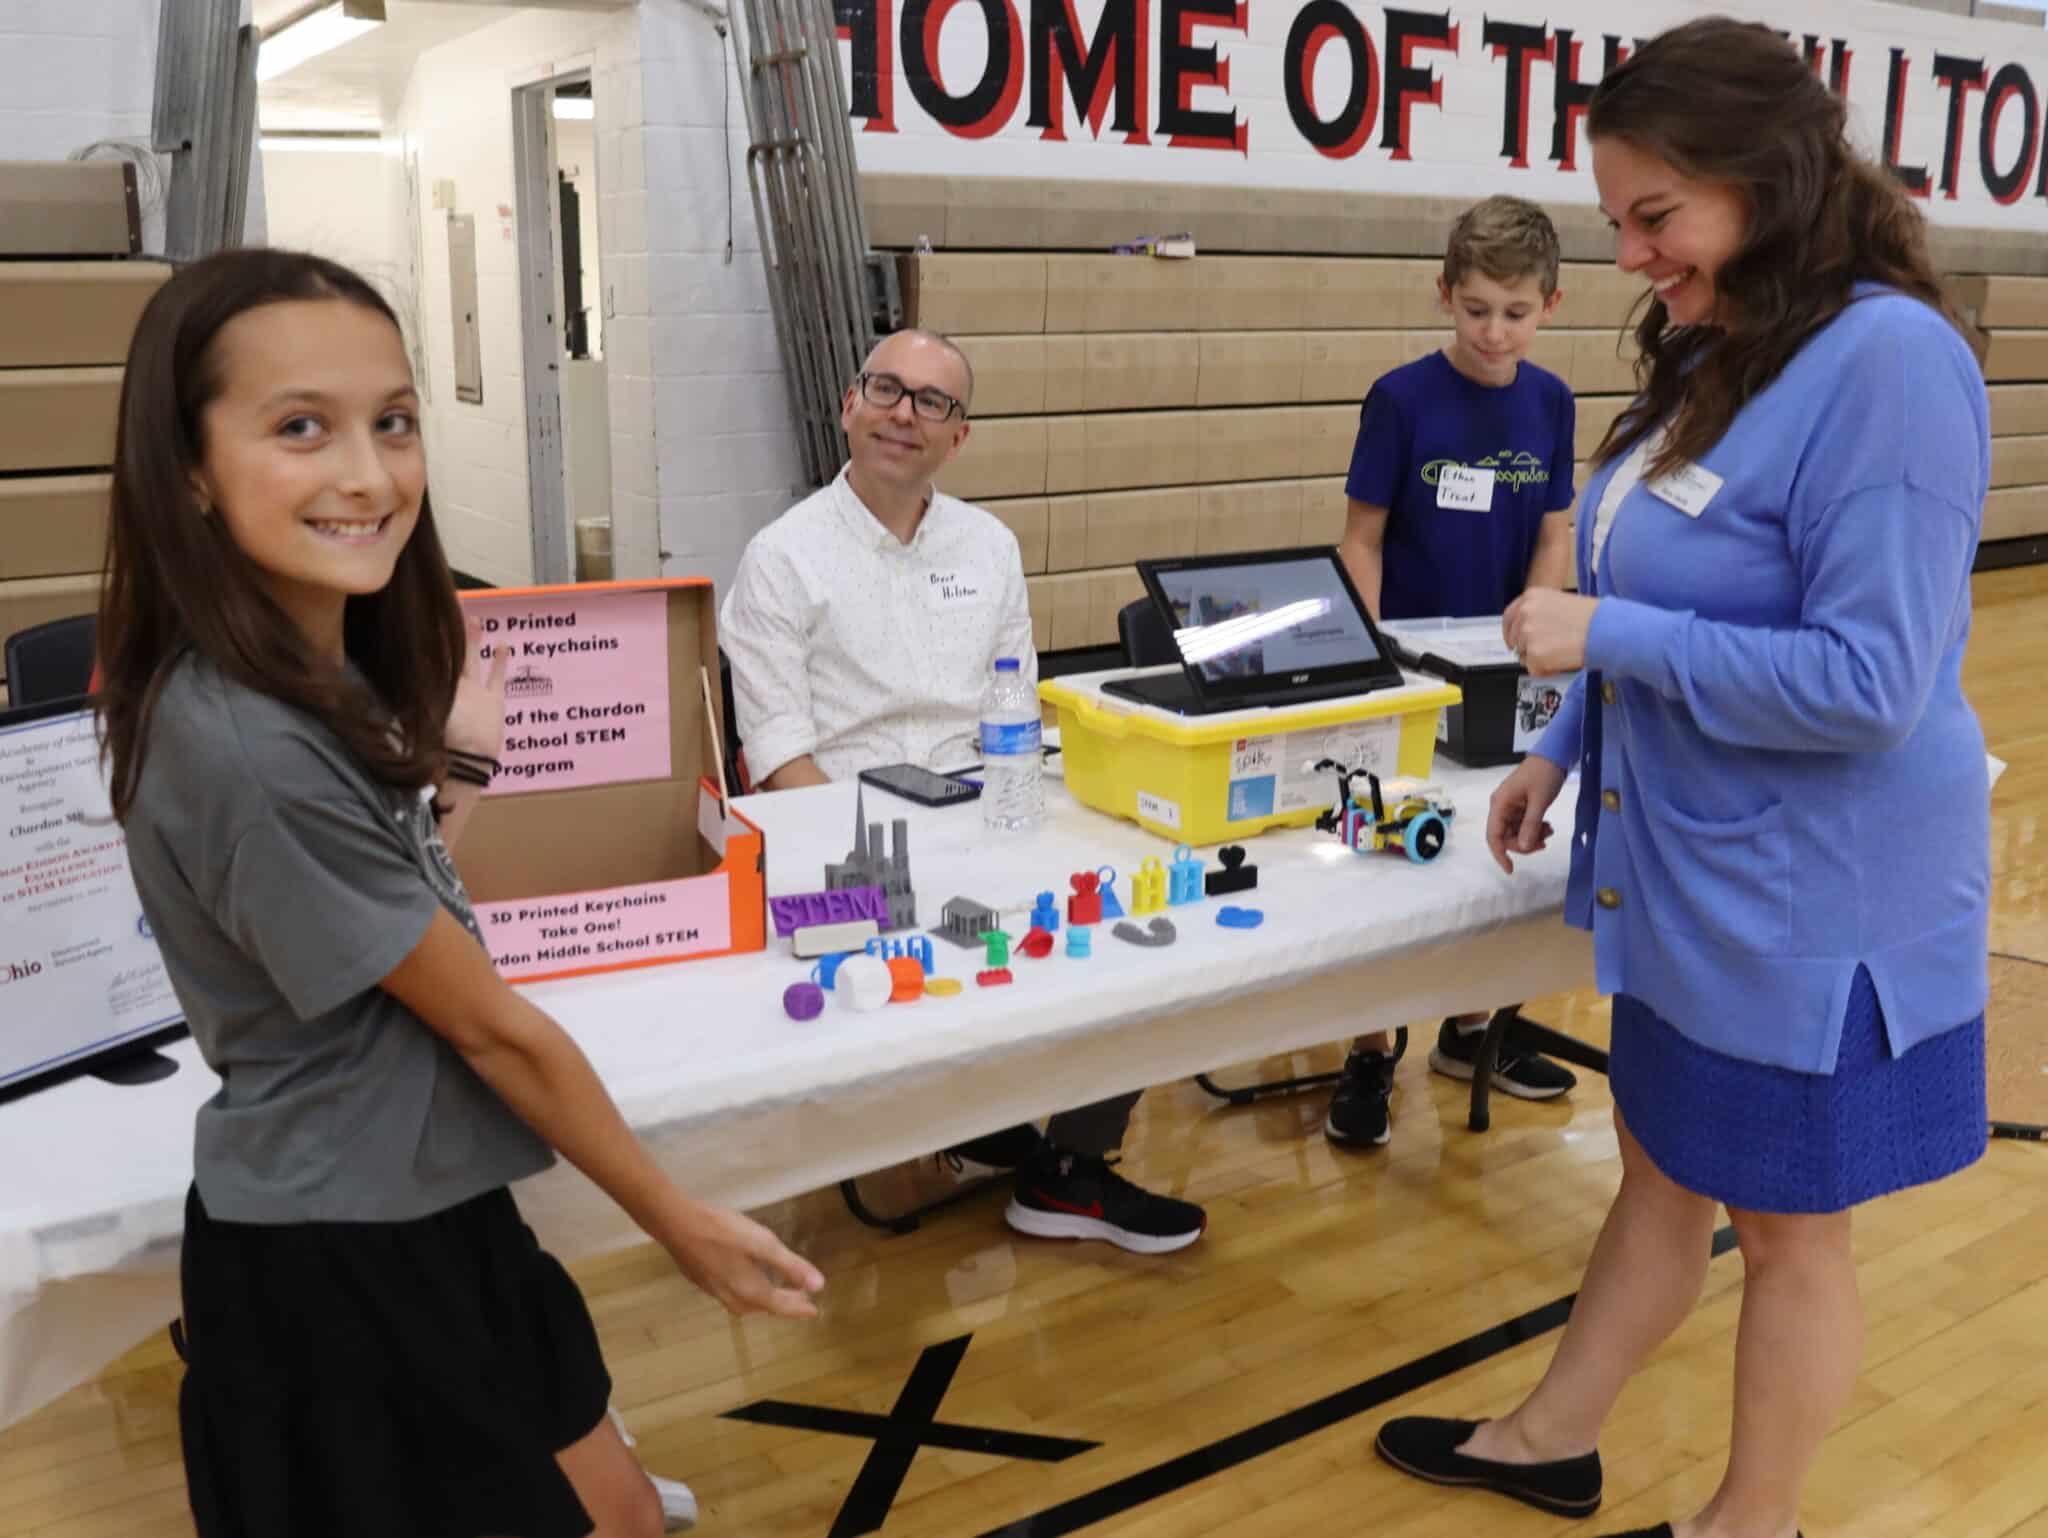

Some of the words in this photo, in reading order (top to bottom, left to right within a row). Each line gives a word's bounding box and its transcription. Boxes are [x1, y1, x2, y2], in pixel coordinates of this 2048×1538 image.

[1284, 0, 1460, 160] OF
[1483, 10, 1652, 172] TH
[507, 612, 576, 632] Printed
[523, 635, 619, 658] Keychains
[504, 711, 523, 726] of
[530, 708, 560, 724] the
[566, 701, 646, 720] Chardon
[505, 732, 569, 751] School
[575, 727, 626, 745] STEM
[492, 759, 574, 778] Program
[9, 818, 63, 839] Chardon
[490, 912, 513, 925] 3D
[519, 903, 578, 921] Printed
[585, 891, 667, 913] Keychains
[770, 887, 884, 928] STEM
[539, 926, 578, 940] Take
[584, 918, 621, 934] One!
[492, 953, 532, 967] rdon
[537, 943, 591, 961] Middle
[597, 935, 649, 953] School
[656, 928, 699, 945] STEM
